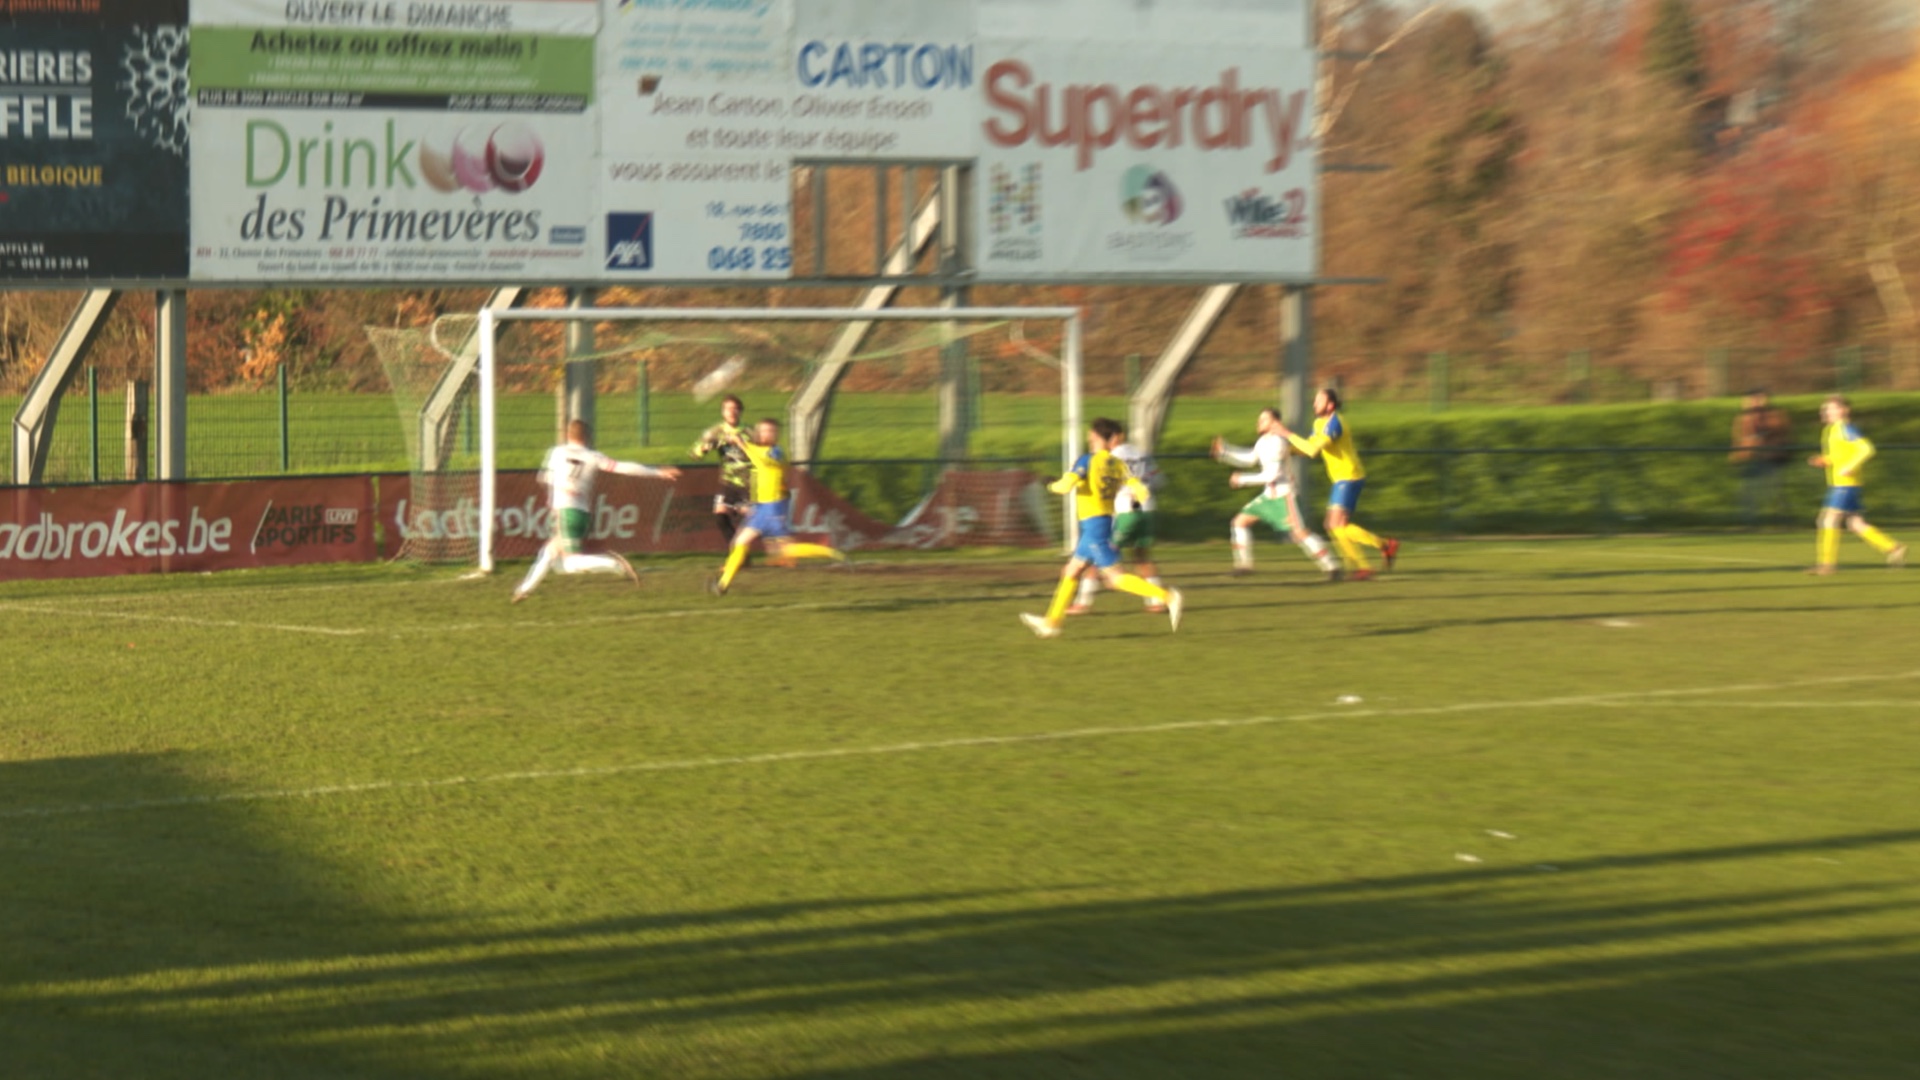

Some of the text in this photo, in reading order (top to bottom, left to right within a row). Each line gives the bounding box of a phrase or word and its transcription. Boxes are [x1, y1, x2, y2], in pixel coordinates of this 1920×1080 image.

[285, 0, 513, 29] OUVERT LE DIMANCHE
[250, 29, 343, 54] Achetez
[350, 36, 379, 55] ou
[385, 32, 453, 58] offrez
[459, 34, 524, 60] malin
[796, 40, 974, 90] CARTON
[0, 96, 93, 138] FFLE
[652, 92, 703, 116] Jean
[708, 92, 788, 119] Carton,
[791, 94, 864, 118] Olivier
[685, 126, 899, 152] et toute leur équipe
[245, 118, 418, 189] Drink
[7, 165, 103, 188] BELGIQUE
[609, 160, 784, 182] vous assurent le
[240, 192, 541, 243] des Primevères
[605, 240, 647, 267] AXA
[708, 246, 793, 271] 068 25
[264, 505, 356, 525] PARIS LIVE
[255, 525, 357, 547] SPORTIFS
